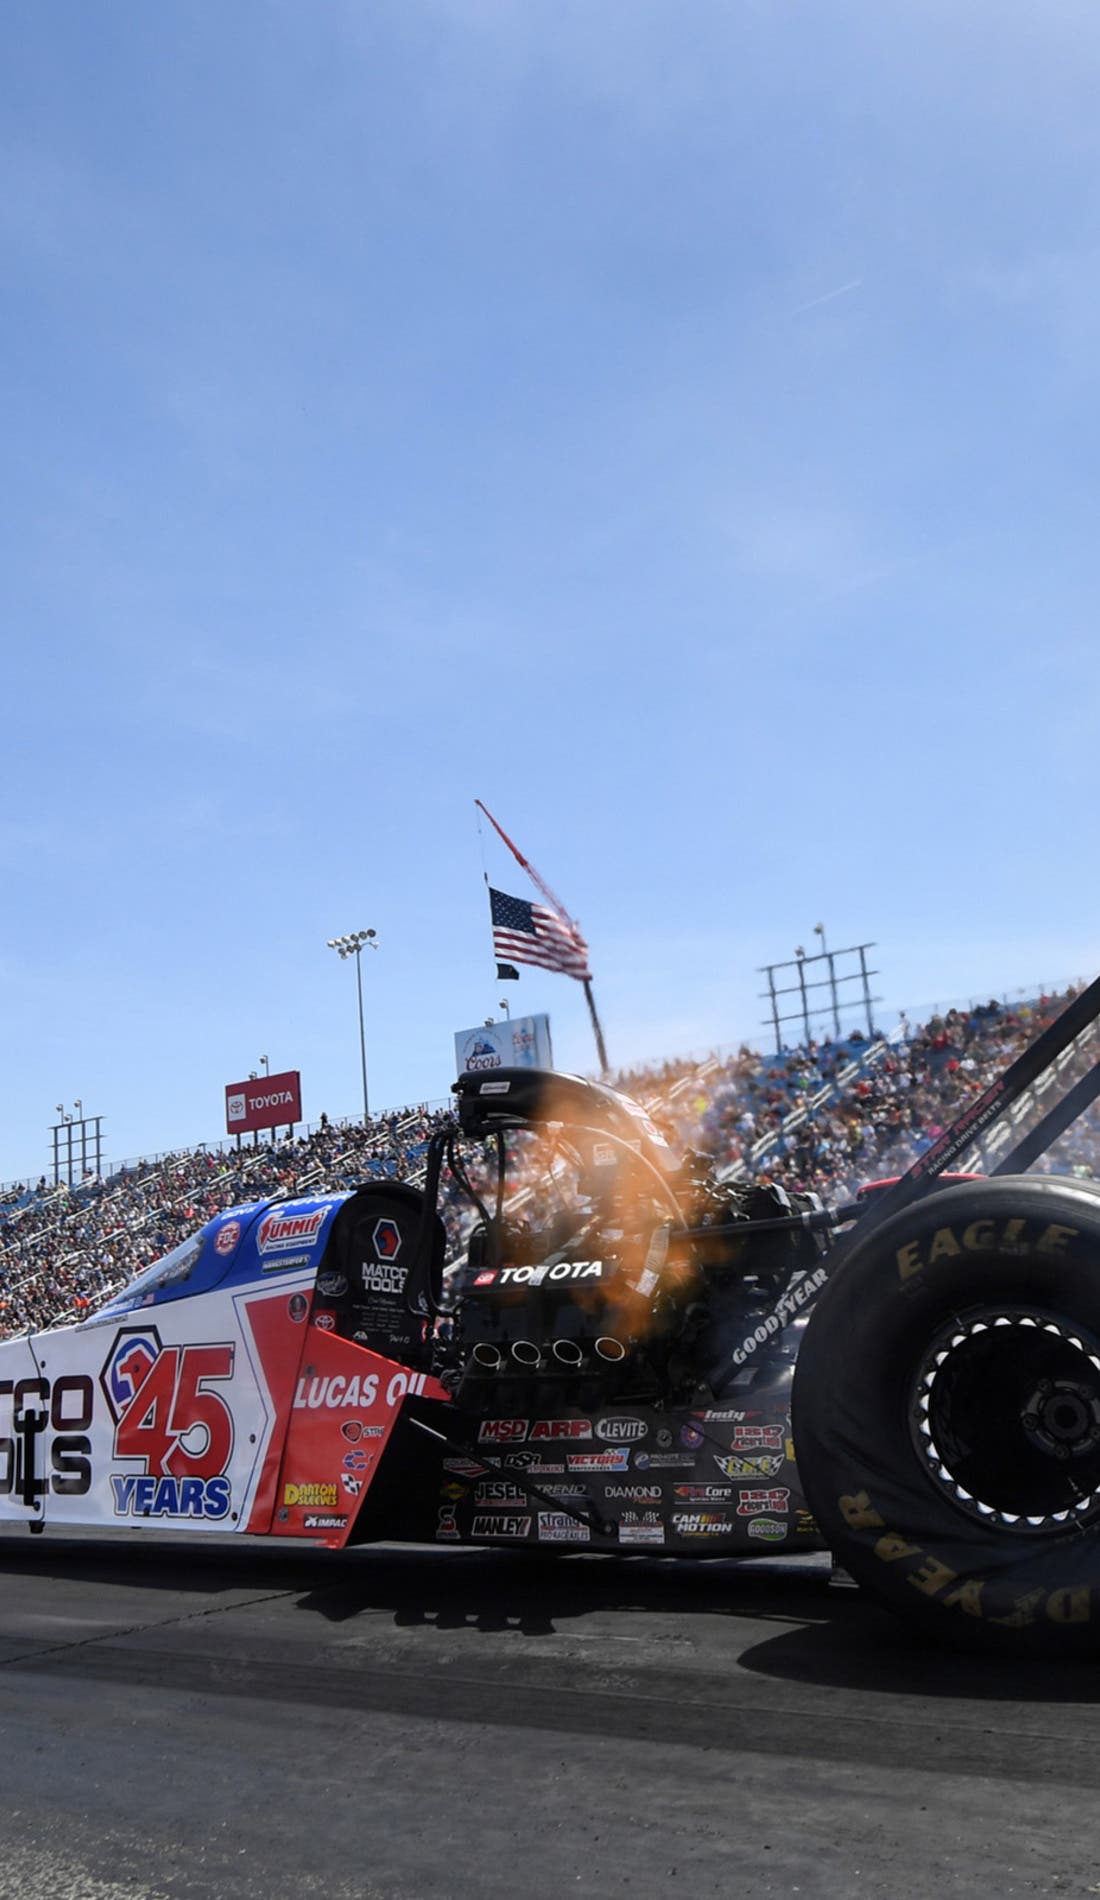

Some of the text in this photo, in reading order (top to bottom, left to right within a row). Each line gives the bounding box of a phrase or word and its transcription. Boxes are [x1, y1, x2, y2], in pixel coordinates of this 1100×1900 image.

[465, 1055, 502, 1071] Coors
[249, 1091, 293, 1110] TOYOTA
[956, 1124, 978, 1148] DRIVE
[260, 1213, 322, 1245] SUMMIT
[896, 1217, 1081, 1281] EAGLE
[732, 1268, 829, 1366] GOODYEAR
[293, 1372, 428, 1409] LUCAS OIL
[113, 1341, 235, 1479] 45
[703, 1409, 745, 1421] Indy
[482, 1420, 528, 1438] MSD
[530, 1420, 591, 1440] ARP
[600, 1419, 646, 1438] CLEVITE
[568, 1455, 624, 1464] VICTORY
[110, 1473, 231, 1519] YEARS
[475, 1482, 527, 1500] JESEL
[535, 1483, 587, 1495] TREND
[604, 1486, 662, 1498] DIAMOND
[474, 1518, 522, 1535] MANLEY
[672, 1514, 700, 1523] CAM
[677, 1523, 732, 1532] MOTION
[750, 1524, 786, 1534] GOODSON
